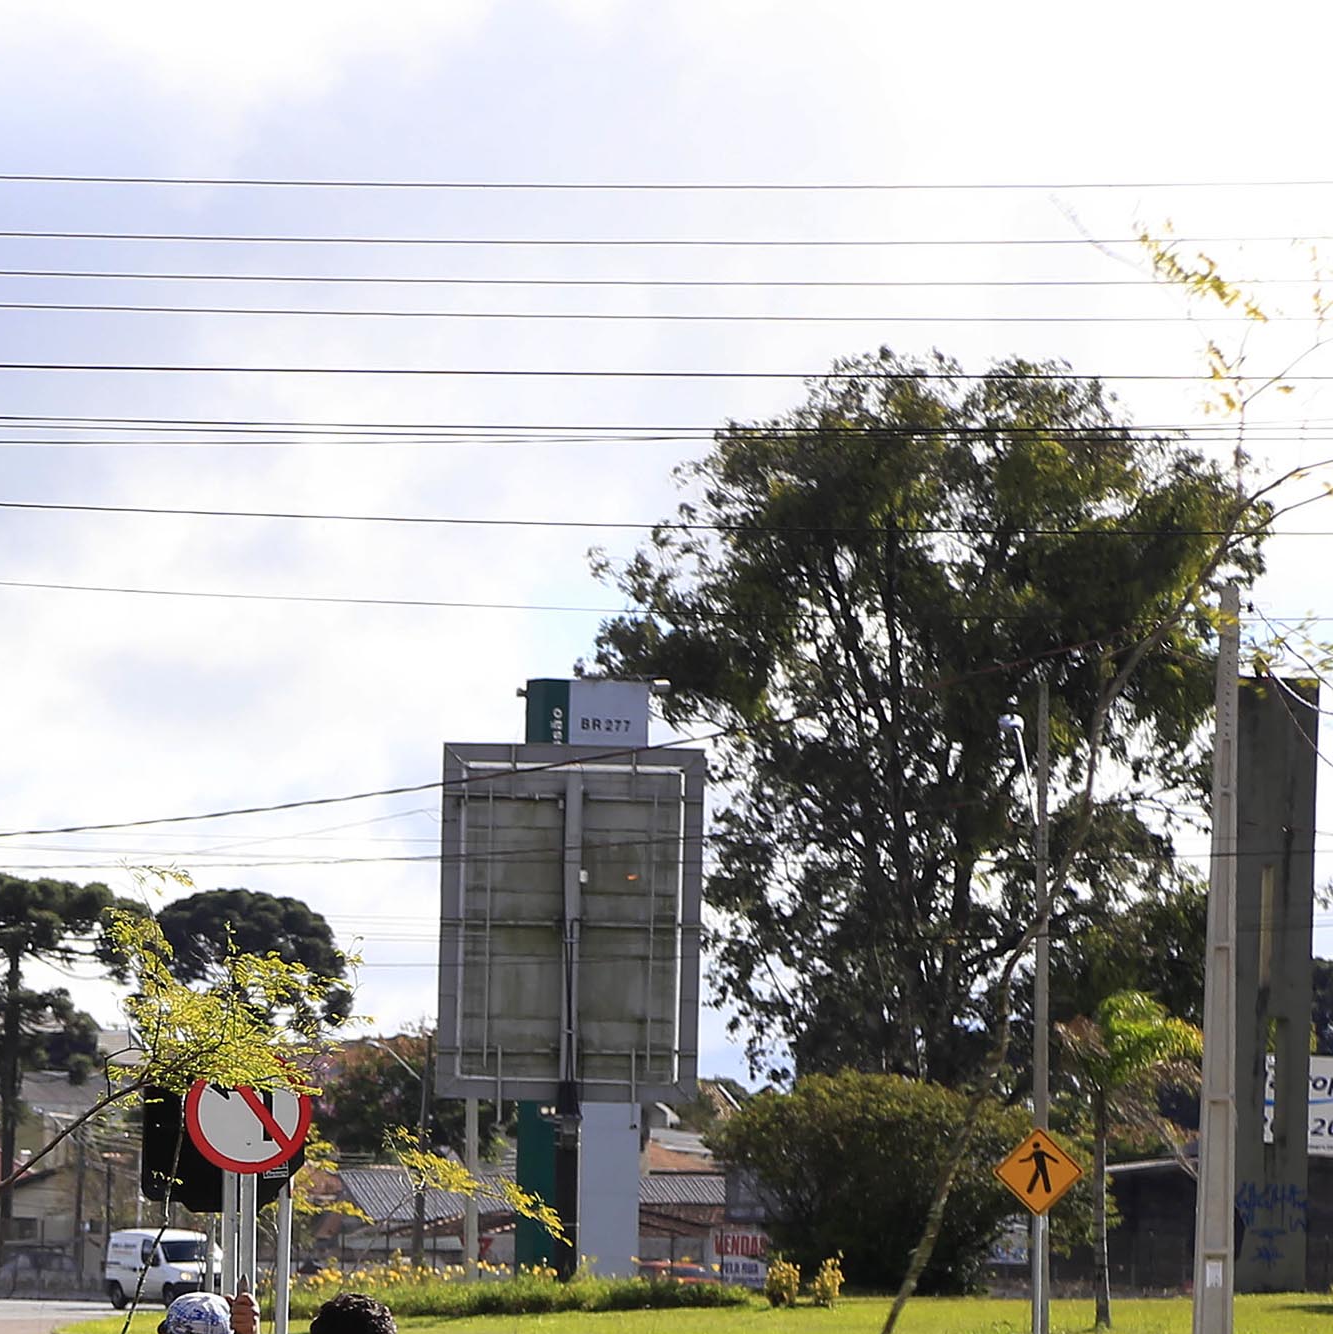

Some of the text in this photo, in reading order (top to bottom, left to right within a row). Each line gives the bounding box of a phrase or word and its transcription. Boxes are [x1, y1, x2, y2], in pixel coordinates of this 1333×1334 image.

[581, 717, 632, 732] BR 277
[714, 1233, 769, 1256] VENDAS
